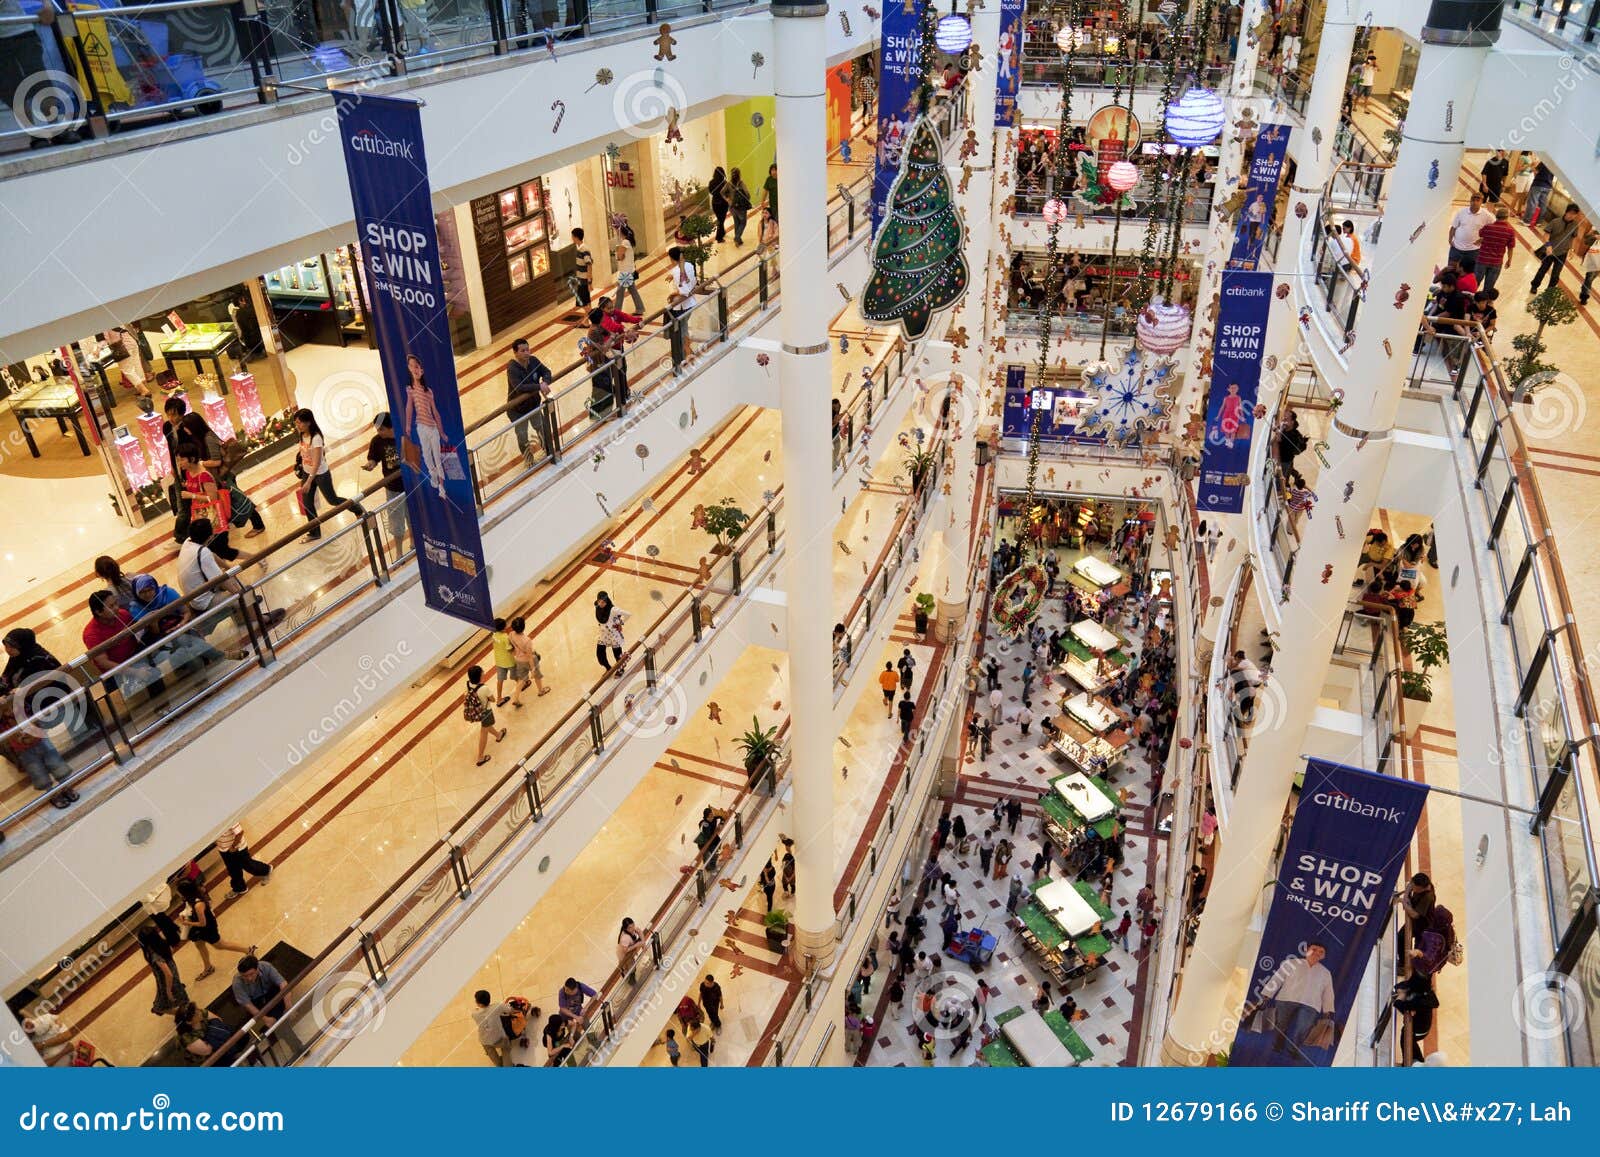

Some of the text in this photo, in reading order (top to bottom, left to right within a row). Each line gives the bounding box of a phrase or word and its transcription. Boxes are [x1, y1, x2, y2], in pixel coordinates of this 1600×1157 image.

[887, 36, 923, 49] SHOP
[885, 52, 893, 62] &
[351, 130, 414, 159] citibank
[606, 171, 635, 188] SALE
[1259, 166, 1278, 176] WIN
[366, 223, 427, 254] SHOP
[371, 252, 432, 284] & WIN
[375, 281, 436, 308] RM15,000
[1226, 286, 1265, 297] citibank
[1222, 325, 1261, 337] SHOP
[1220, 337, 1260, 349] & WIN
[1219, 350, 1258, 360] RM15,000
[1313, 792, 1401, 824] citibank
[1297, 854, 1383, 889] SHOP
[1290, 877, 1377, 910] & WIN
[1286, 894, 1369, 926] RM15,000
